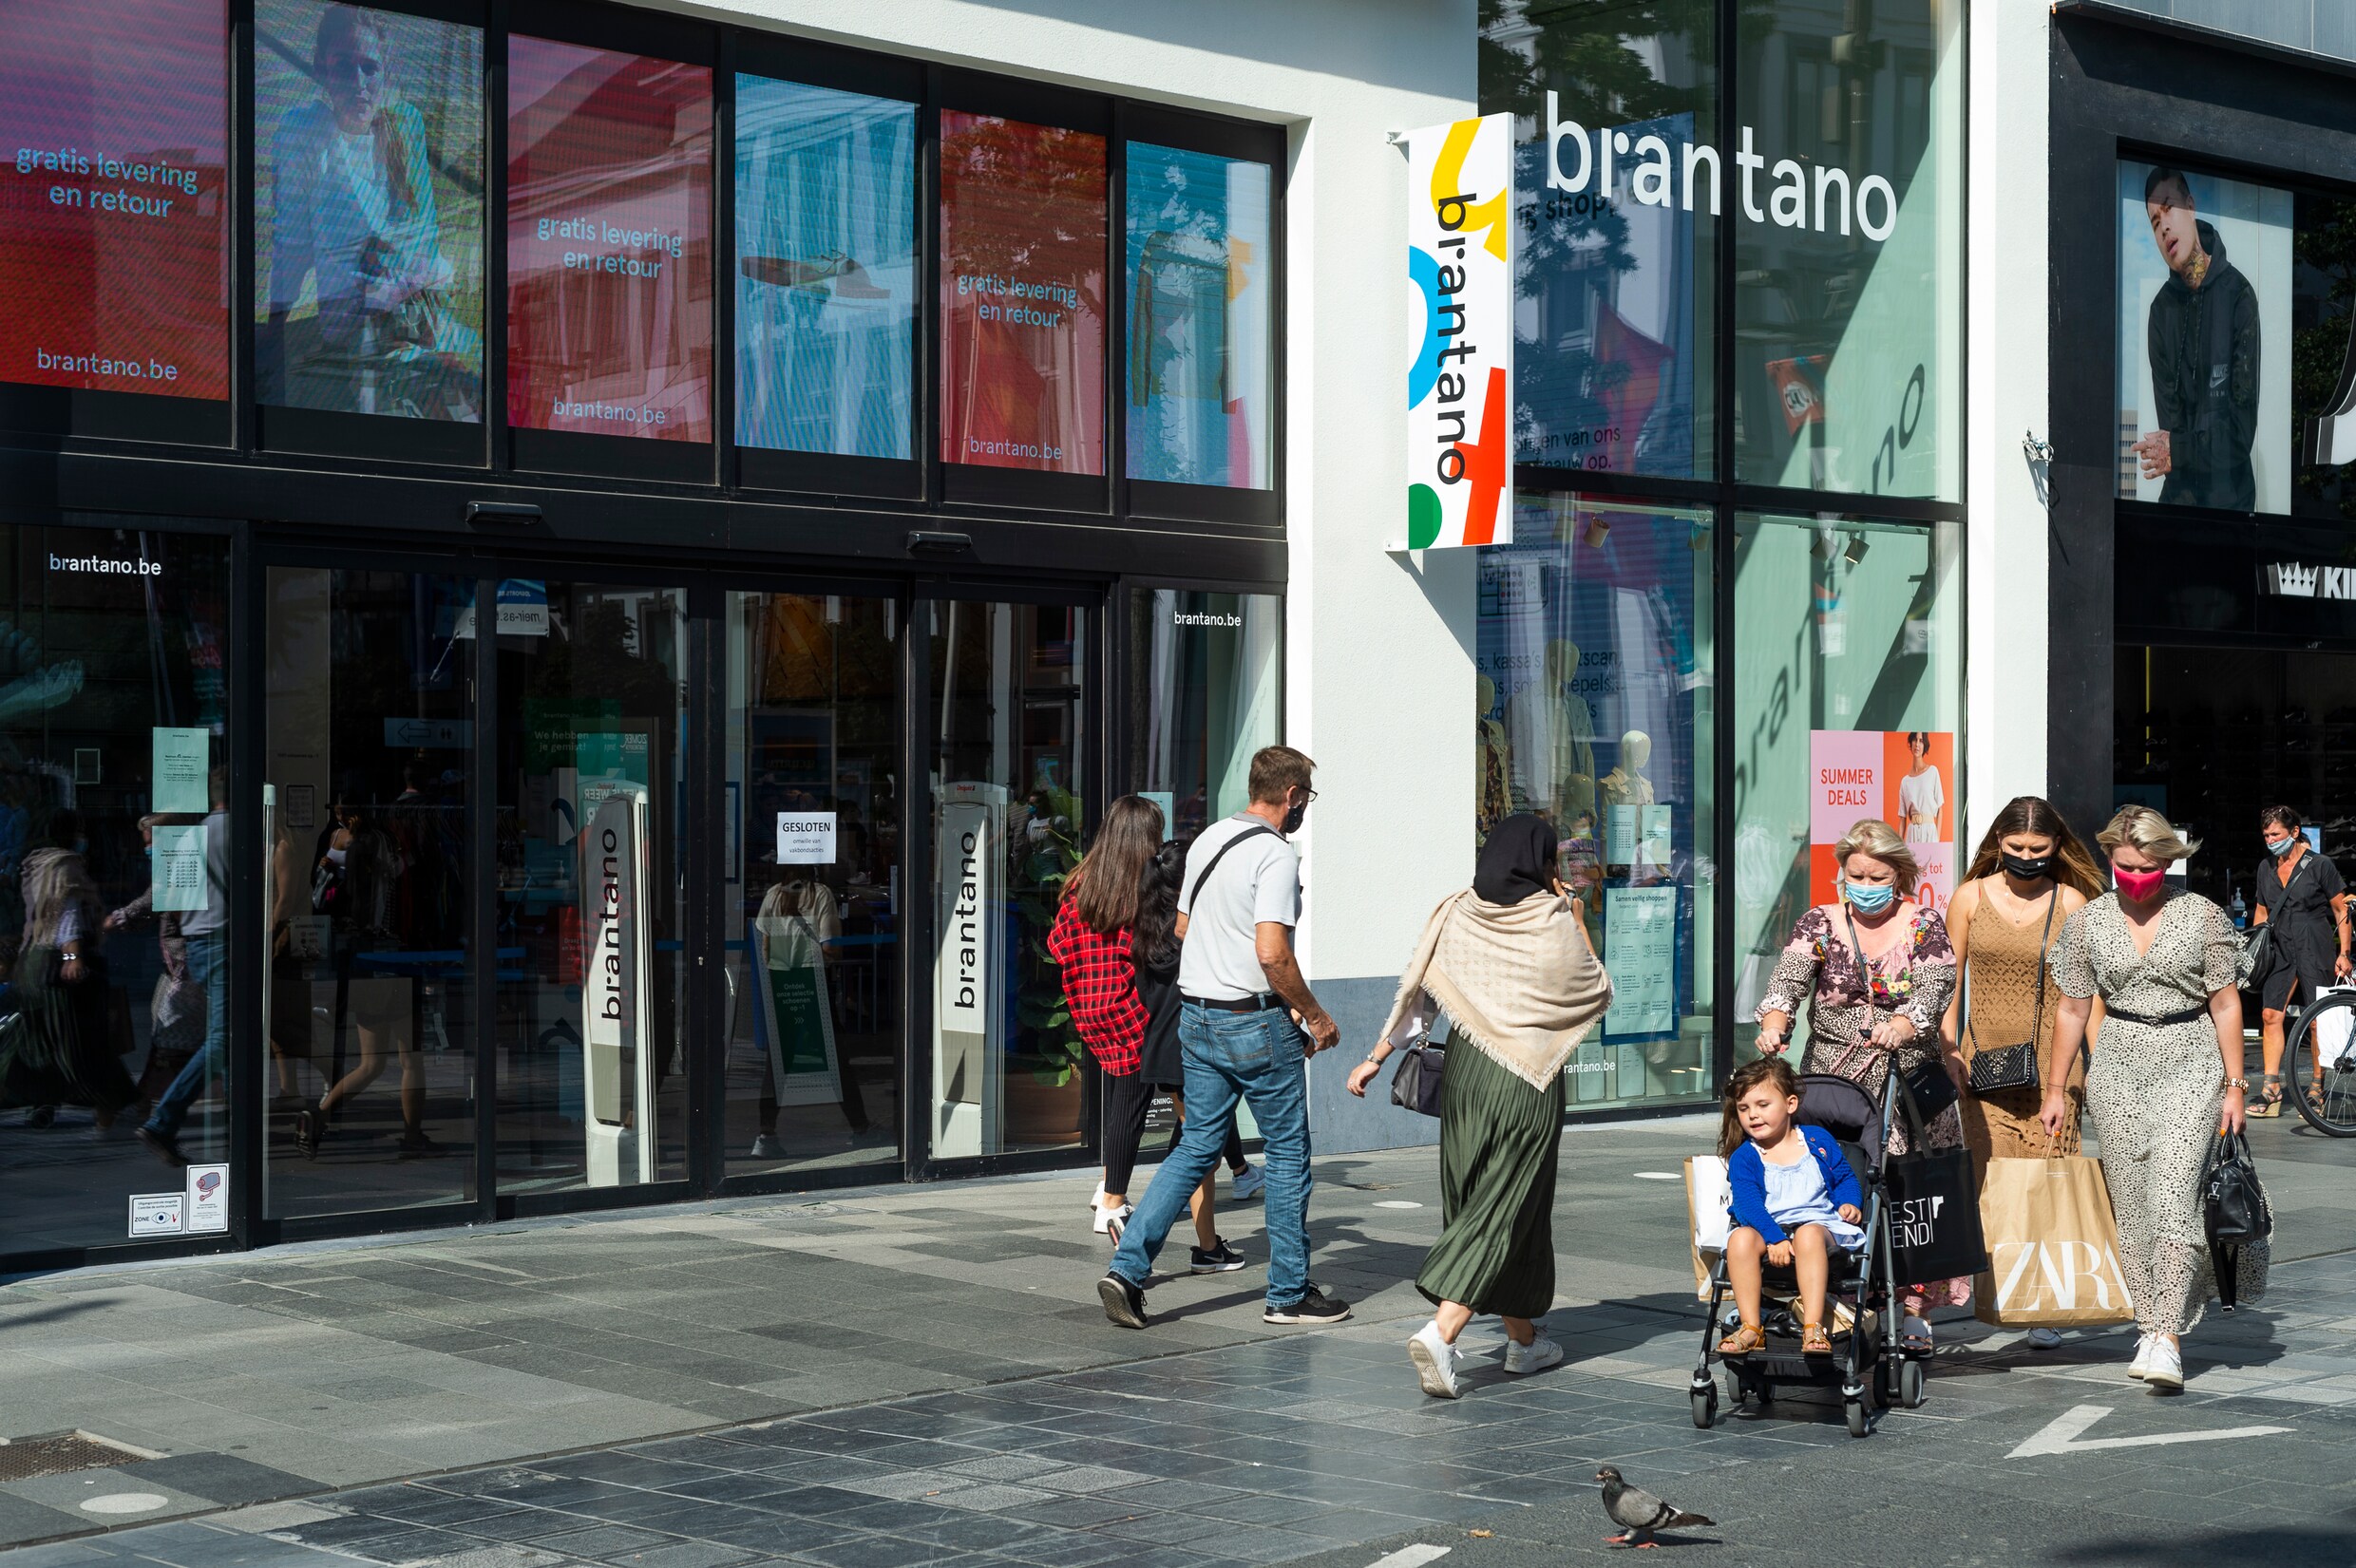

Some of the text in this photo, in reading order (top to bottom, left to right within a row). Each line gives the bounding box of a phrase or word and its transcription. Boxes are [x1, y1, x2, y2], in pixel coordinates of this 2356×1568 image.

[16, 145, 199, 195] gratis levering
[1547, 90, 1898, 241] brantano
[49, 185, 173, 218] en retour
[538, 215, 682, 257] gratis levering
[563, 250, 662, 279] en retour
[958, 272, 1078, 310] gratis levering
[978, 302, 1061, 328] en retour
[1437, 193, 1477, 485] brantano
[37, 348, 179, 381] brantano.be
[553, 398, 665, 425] brantano.be
[969, 436, 1063, 461] brantano.be
[1564, 430, 1589, 447] van
[1594, 426, 1622, 444] ons
[49, 553, 162, 576] brantano.be
[1174, 611, 1242, 627] brantano.be
[1820, 768, 1873, 785] SUMMER
[1828, 789, 1867, 805] DEALS
[782, 822, 831, 833] GESLOTEN
[1929, 862, 1944, 875] tot
[1645, 894, 1667, 902] shoppen
[599, 828, 622, 1021] brantano
[955, 830, 977, 1010] brantano
[783, 982, 806, 991] Ontdek
[791, 989, 815, 997] selectie
[1563, 1059, 1616, 1074] rantano.be
[1993, 1238, 2135, 1312] ZARA
